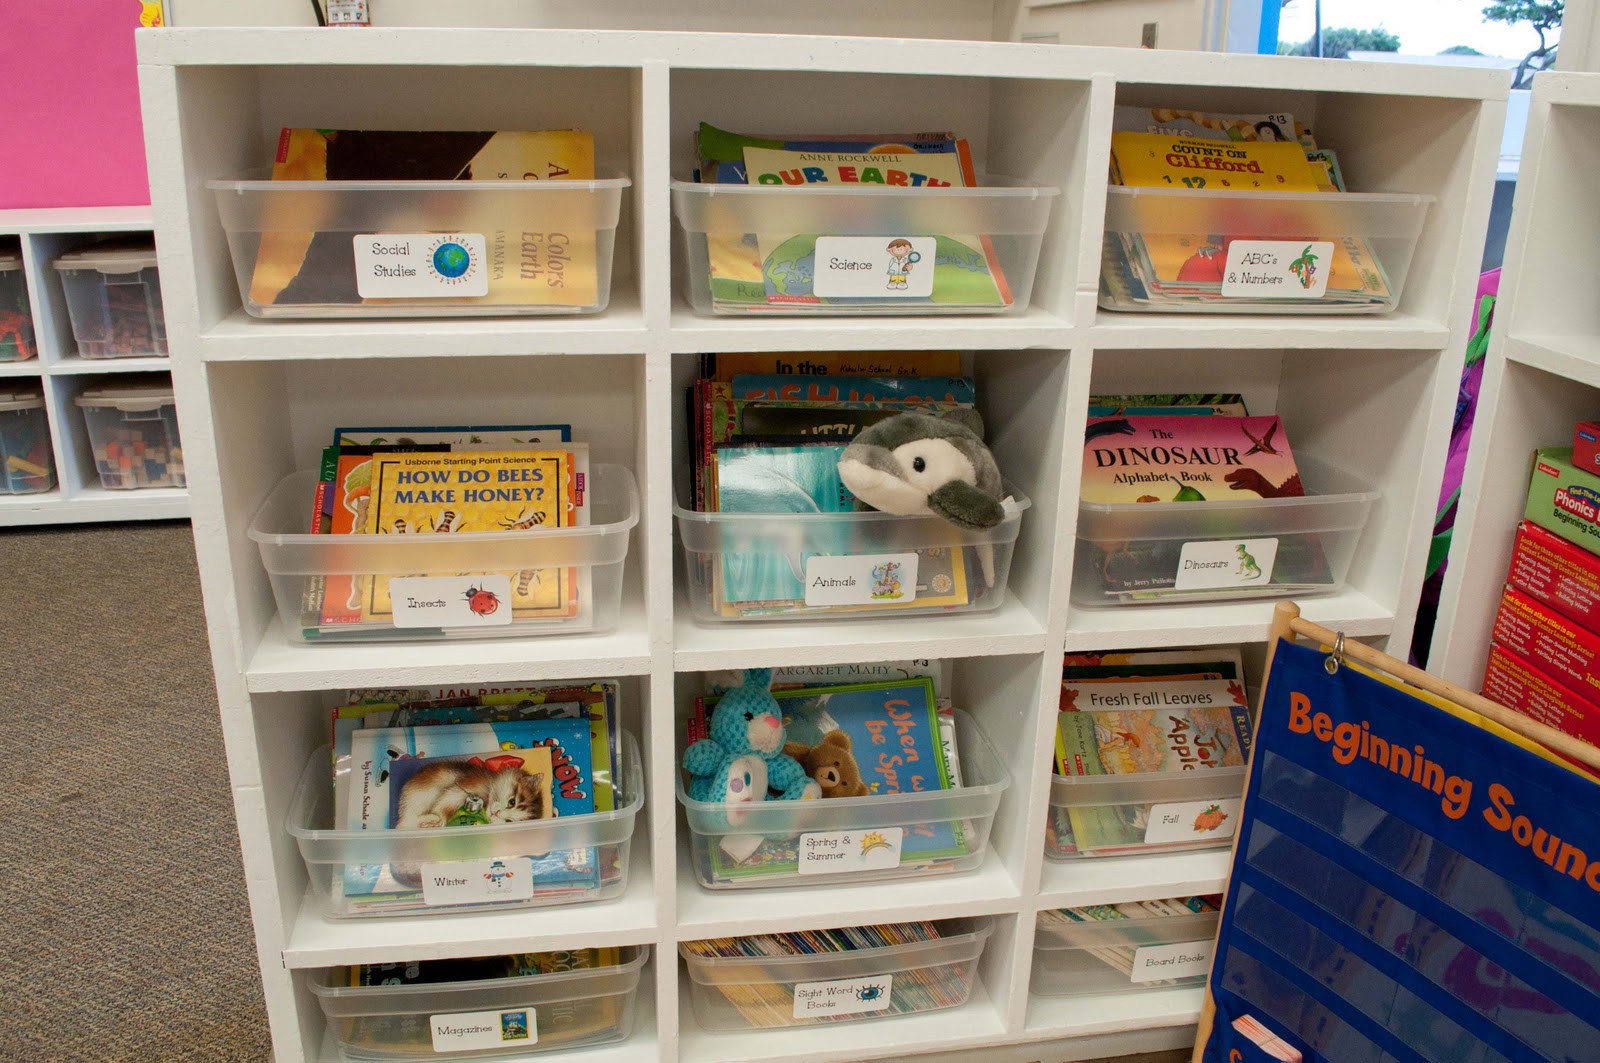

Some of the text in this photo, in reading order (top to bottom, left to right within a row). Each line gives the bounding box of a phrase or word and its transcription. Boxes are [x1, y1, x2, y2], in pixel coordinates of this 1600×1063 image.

[799, 153, 902, 163] ANNE ROCKWELL
[1172, 144, 1247, 159] COUNT ON
[1165, 153, 1264, 173] Clifford
[758, 167, 828, 185] OUR
[1181, 175, 1206, 188] 12
[1221, 179, 1231, 187] 8
[1276, 174, 1285, 184] 9
[372, 242, 410, 256] Social
[520, 231, 544, 280] Earth
[547, 232, 571, 288] Colors
[829, 257, 873, 271] Science
[1240, 253, 1277, 265] ABC's
[374, 264, 416, 277] Studies
[1228, 272, 1283, 285] & Numbers
[776, 360, 828, 375] In the
[1149, 429, 1174, 439] The
[443, 458, 477, 466] Starting
[503, 456, 536, 464] Science
[1091, 446, 1243, 467] DINOSAUR
[397, 468, 543, 484] HOW DO BEES
[1113, 471, 1213, 485] Alphabet Book
[394, 487, 545, 504] MAKE HONEY?
[1556, 490, 1595, 518] Phonics
[1553, 508, 1588, 534] Beginning
[1184, 559, 1229, 570] Dinosaurs
[812, 576, 856, 588] Animals
[407, 597, 446, 609] Insects
[435, 688, 474, 699] JAN
[1090, 691, 1213, 706] Fresh Fall Leaves
[864, 720, 888, 745] be
[884, 699, 920, 763] When
[1288, 691, 1473, 820] Beginning
[361, 761, 372, 770] by
[1162, 815, 1179, 824] Fall
[806, 836, 851, 850] Spring &
[807, 852, 846, 861] Summer
[434, 877, 468, 887] Winter
[1146, 953, 1204, 967] Board Books
[798, 986, 853, 1000] Sight Word
[807, 1000, 836, 1009] Books
[438, 1025, 492, 1037] Magazines
